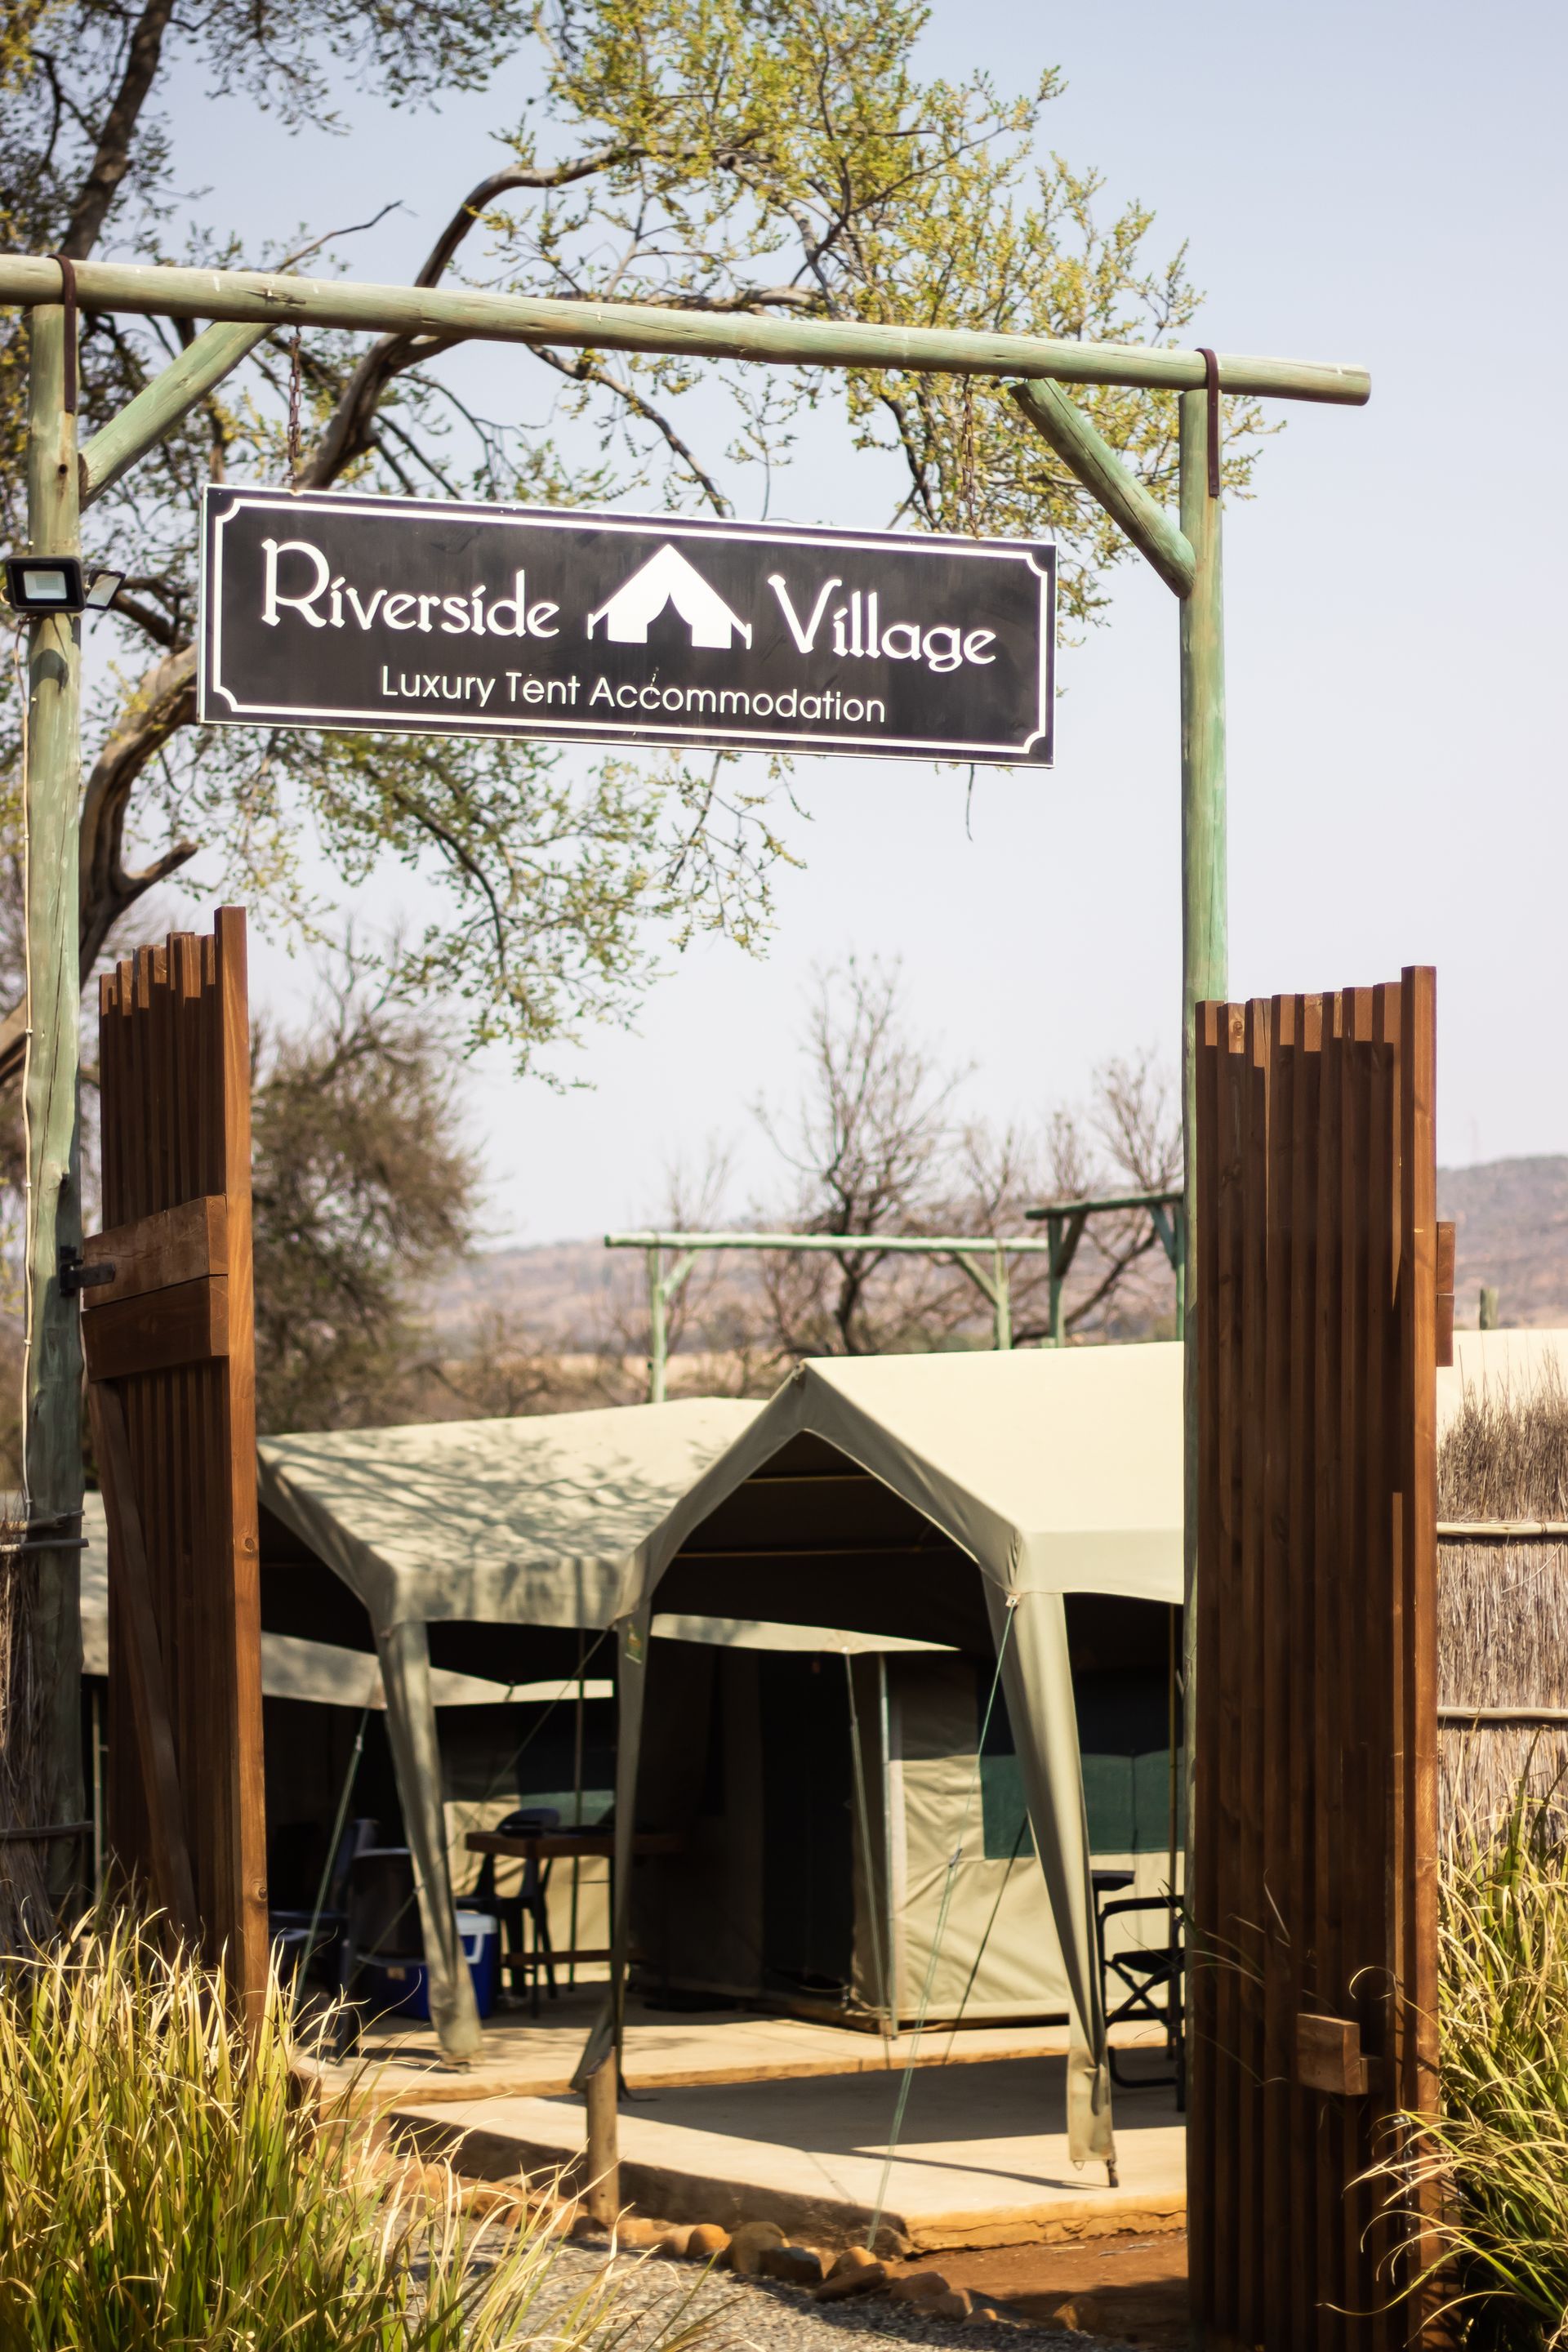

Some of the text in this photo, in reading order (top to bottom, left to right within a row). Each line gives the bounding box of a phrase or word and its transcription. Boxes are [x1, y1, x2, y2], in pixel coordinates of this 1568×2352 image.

[261, 537, 997, 673] Riverside Village
[381, 665, 886, 724] Luxury Tent Accommodation
